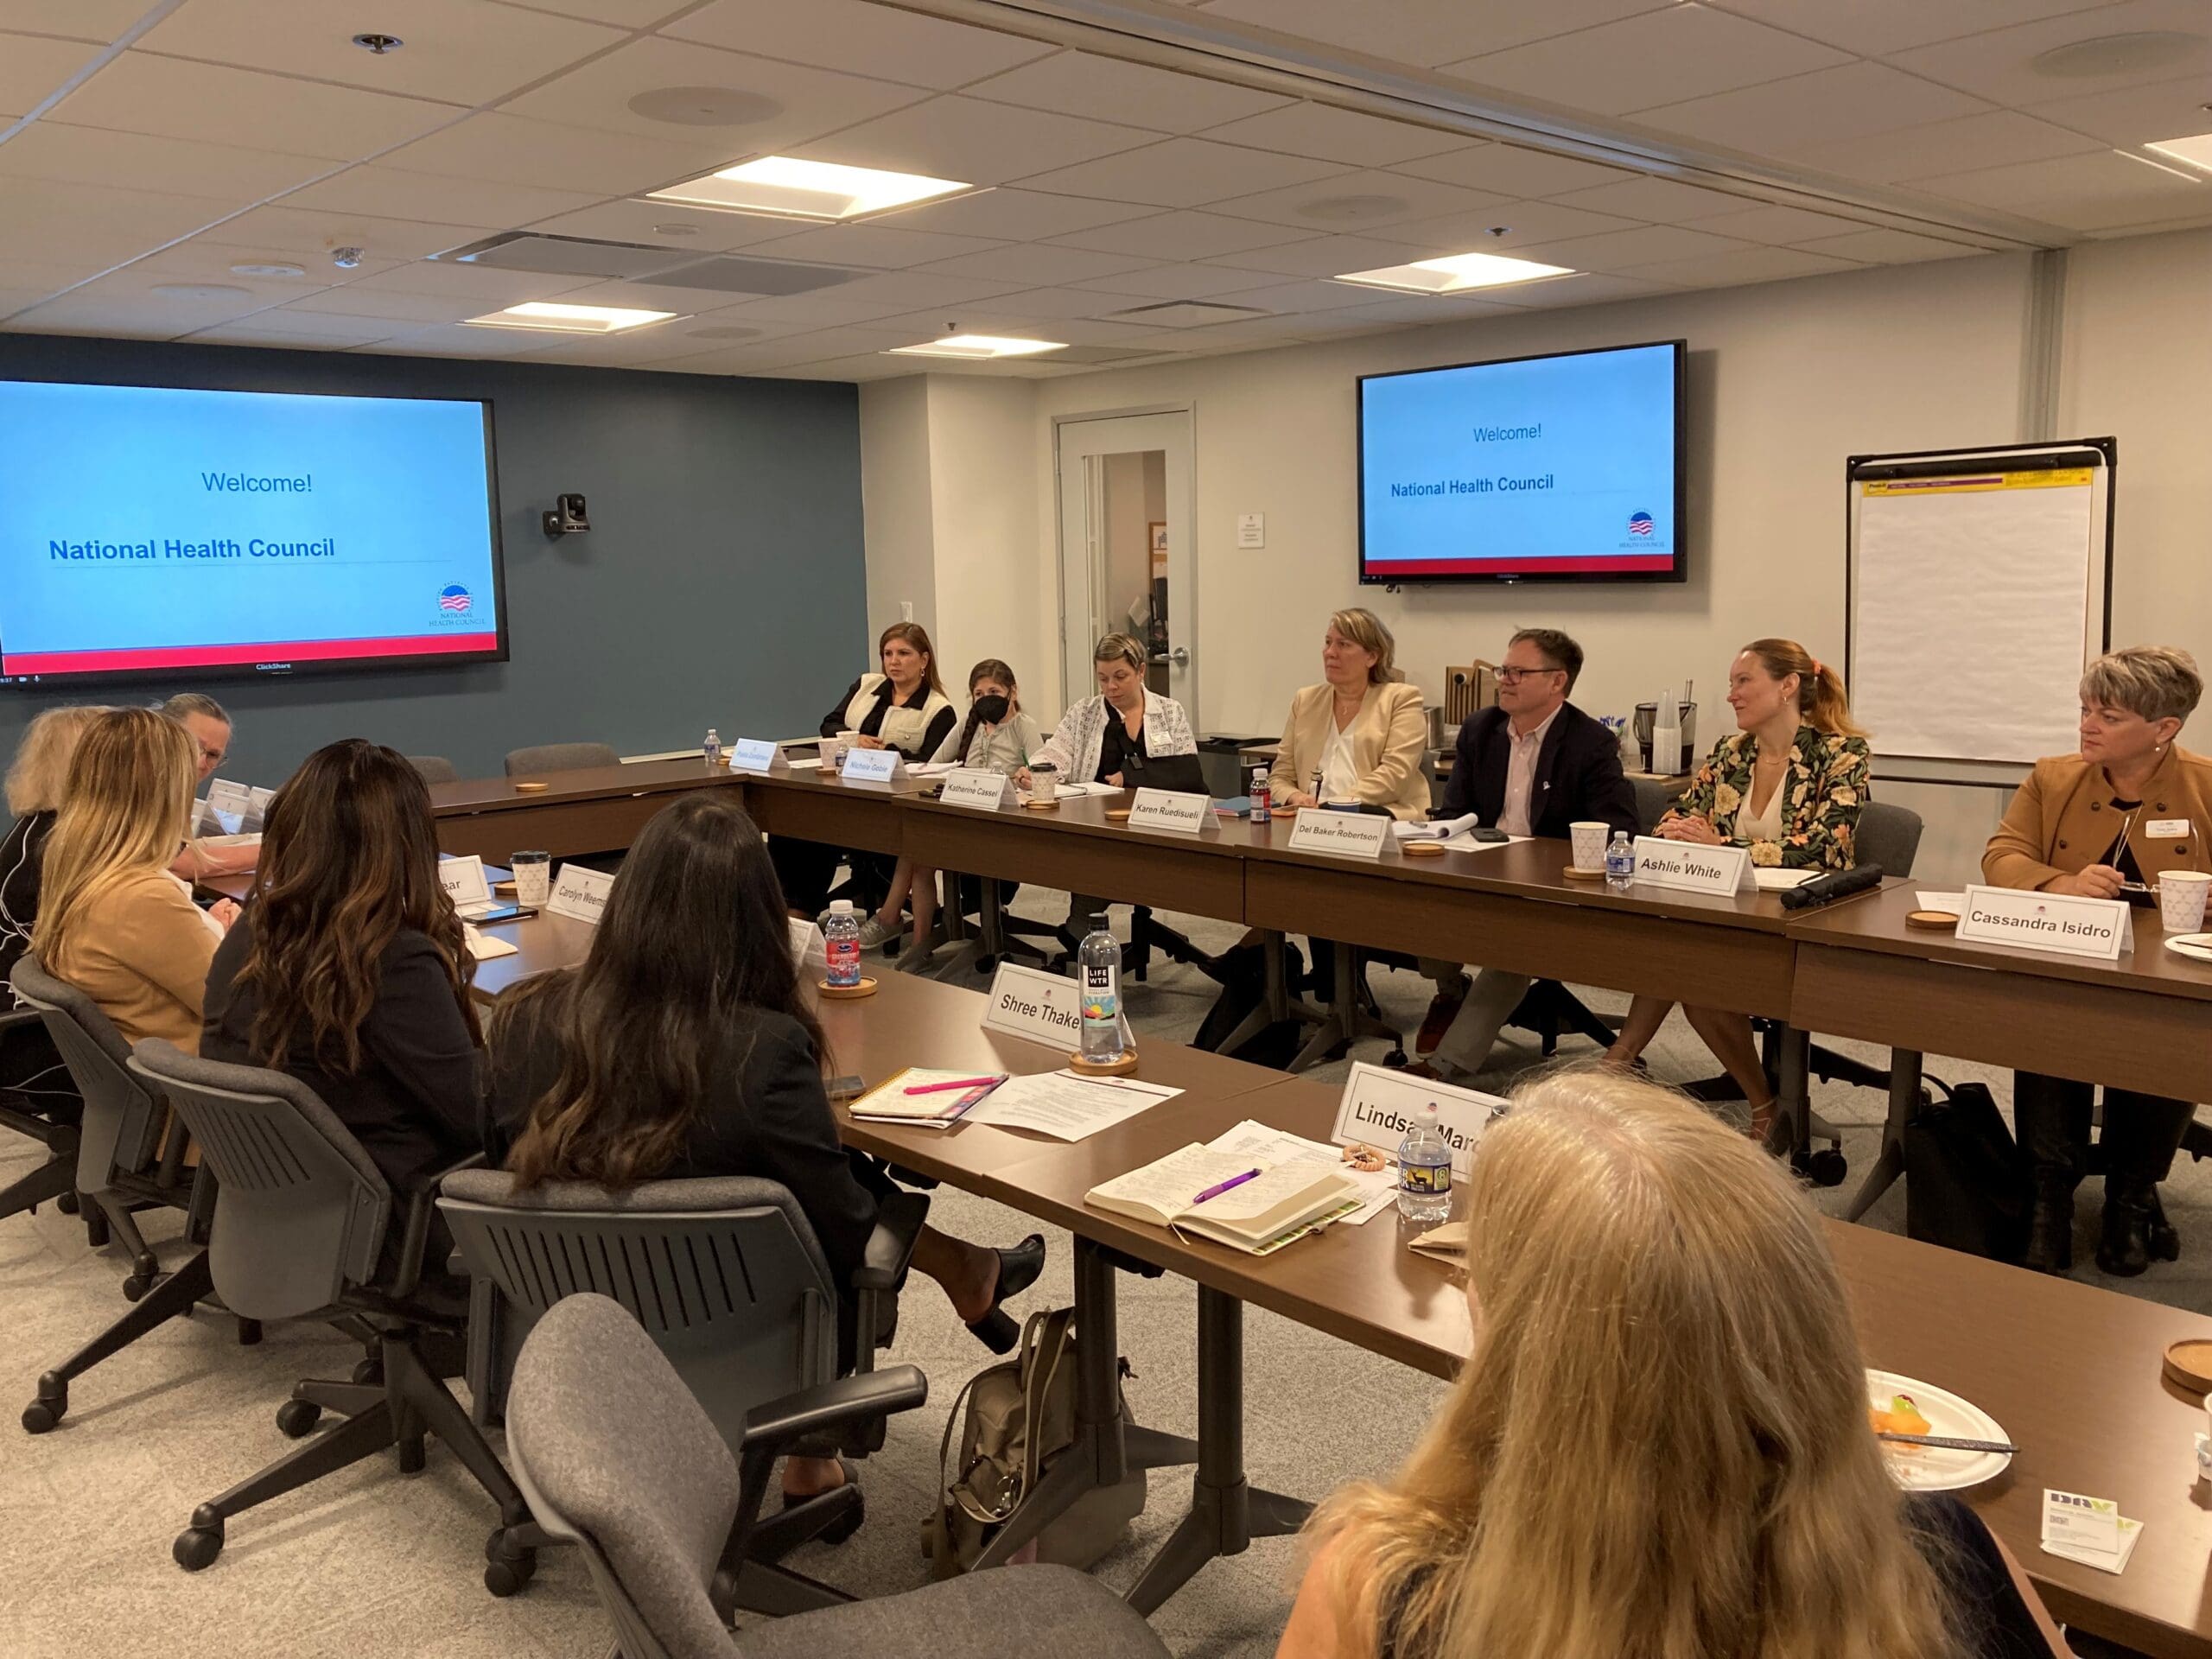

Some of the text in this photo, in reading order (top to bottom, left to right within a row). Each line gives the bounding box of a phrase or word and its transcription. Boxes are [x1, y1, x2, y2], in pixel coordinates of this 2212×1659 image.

[1473, 423, 1541, 442] Welcome!
[201, 473, 312, 493] Welcome!
[1391, 474, 1554, 498] National Health Council
[49, 537, 334, 560] National Health Council
[948, 784, 976, 794] Katherine
[1135, 804, 1198, 819] Karen Ruedisueli
[1299, 824, 1378, 841] Del Baker Robertson
[1641, 858, 1681, 874] Ashlie
[1684, 862, 1721, 879] White
[442, 880, 461, 891] ear
[558, 886, 582, 902] Carolyn
[1971, 911, 2111, 938] Cassandra Isidro
[1001, 994, 1081, 1030] Shree Thake
[1355, 1102, 1415, 1135] Lindsa
